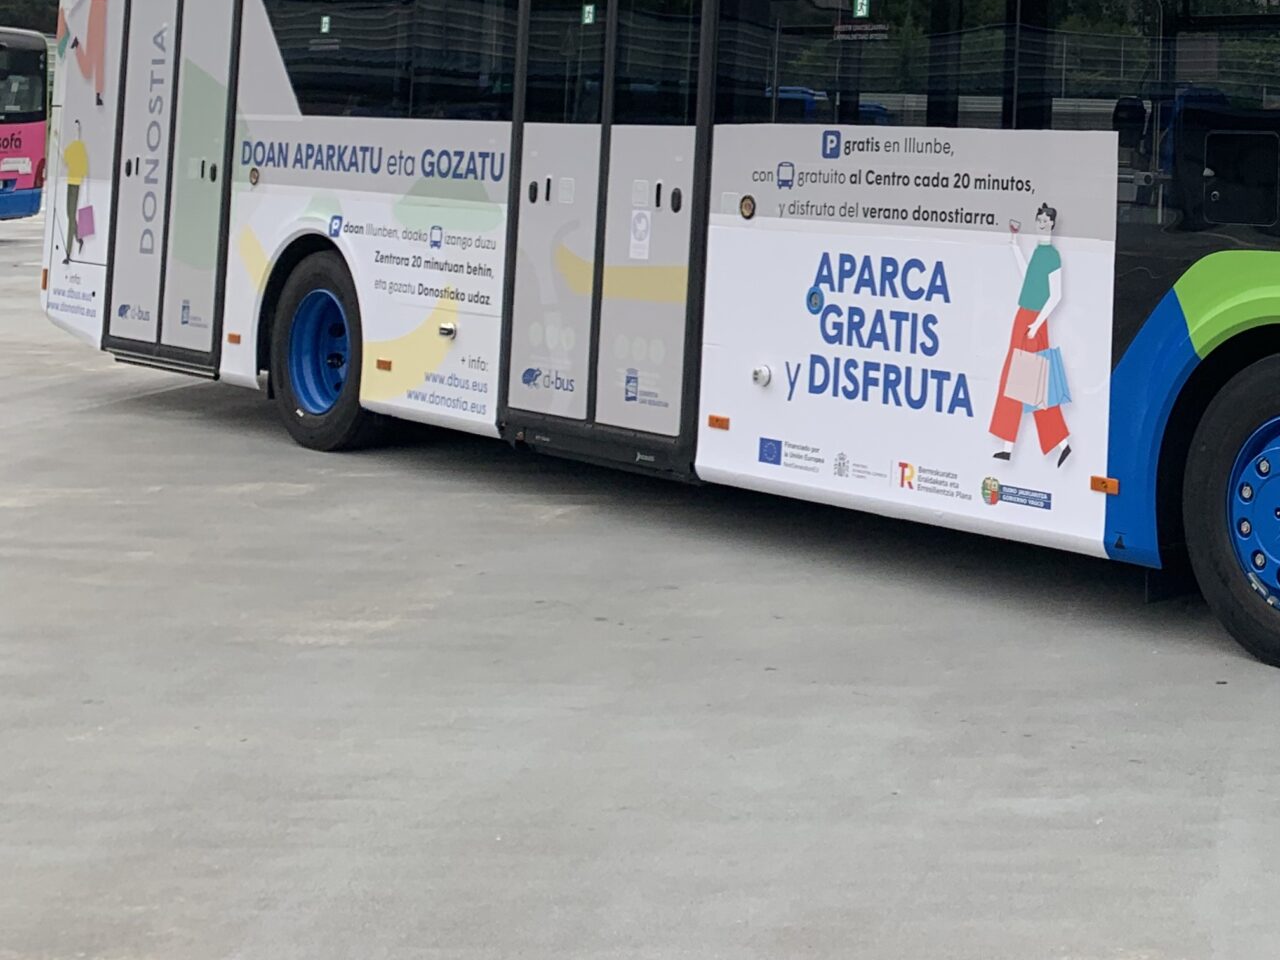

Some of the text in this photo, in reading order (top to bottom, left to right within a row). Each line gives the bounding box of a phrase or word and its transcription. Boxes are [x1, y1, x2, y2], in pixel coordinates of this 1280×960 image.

[139, 26, 168, 255] DONOSTIA
[844, 137, 880, 156] gratis
[884, 141, 900, 152] en
[904, 137, 955, 157] Illunbe,
[241, 140, 505, 182] DOAN APARKATU eta GOZATU
[752, 169, 1036, 195] con gratuito al Centro cada 20 minutos,
[778, 199, 999, 226] y disfruta del verano donostiarra.
[343, 221, 364, 235] doan
[401, 226, 428, 243] doako
[444, 232, 473, 250] izango
[476, 235, 496, 250] duzu
[374, 250, 494, 279] Zentrora 20 minutuan behin,
[813, 252, 951, 303] APARCA
[374, 279, 492, 305] eta gozatu Donostiako udaz.
[820, 304, 939, 357] GRATIS
[468, 355, 489, 372] info:
[424, 371, 488, 393] www.dbus.eus
[785, 353, 974, 418] y DISFRUTA
[406, 389, 487, 415] www.donostia.eus
